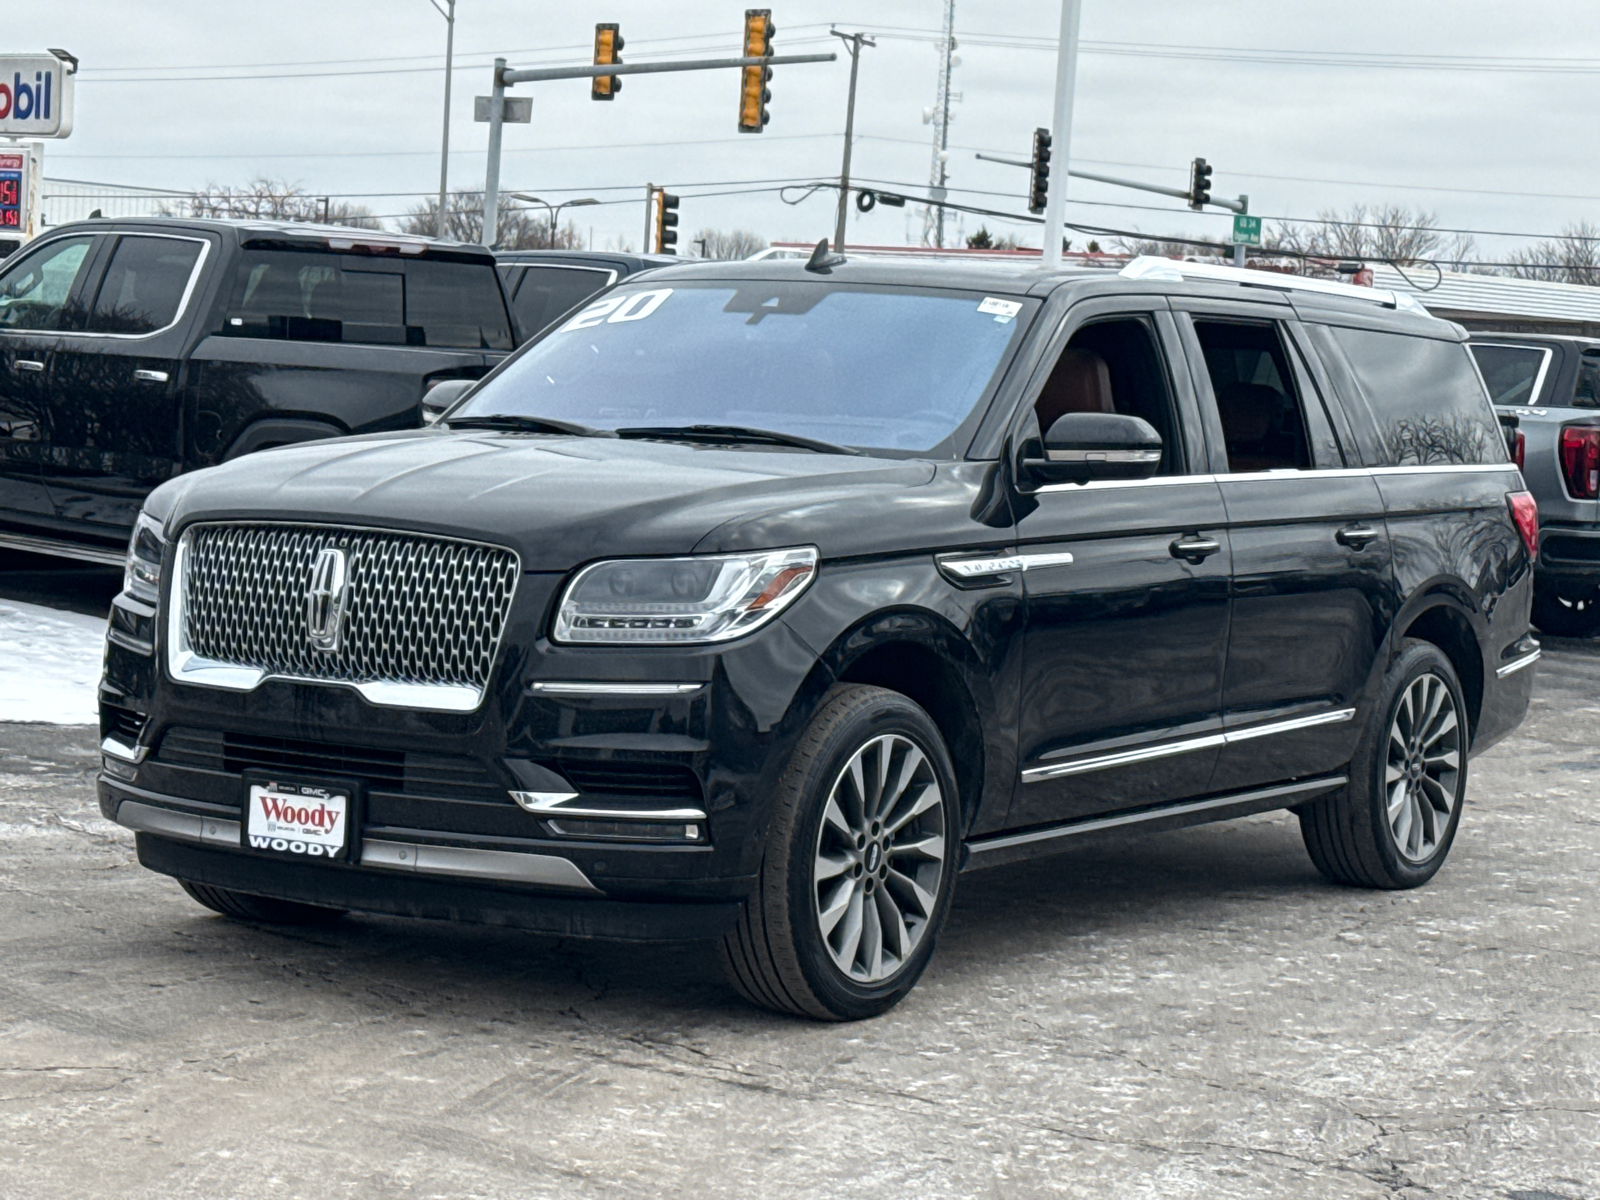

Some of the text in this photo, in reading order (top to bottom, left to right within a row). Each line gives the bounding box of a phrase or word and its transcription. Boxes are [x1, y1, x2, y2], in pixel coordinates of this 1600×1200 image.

[560, 287, 674, 333] 20
[301, 786, 327, 797] GMC
[258, 795, 341, 835] Woody
[248, 834, 341, 858] WOODY
